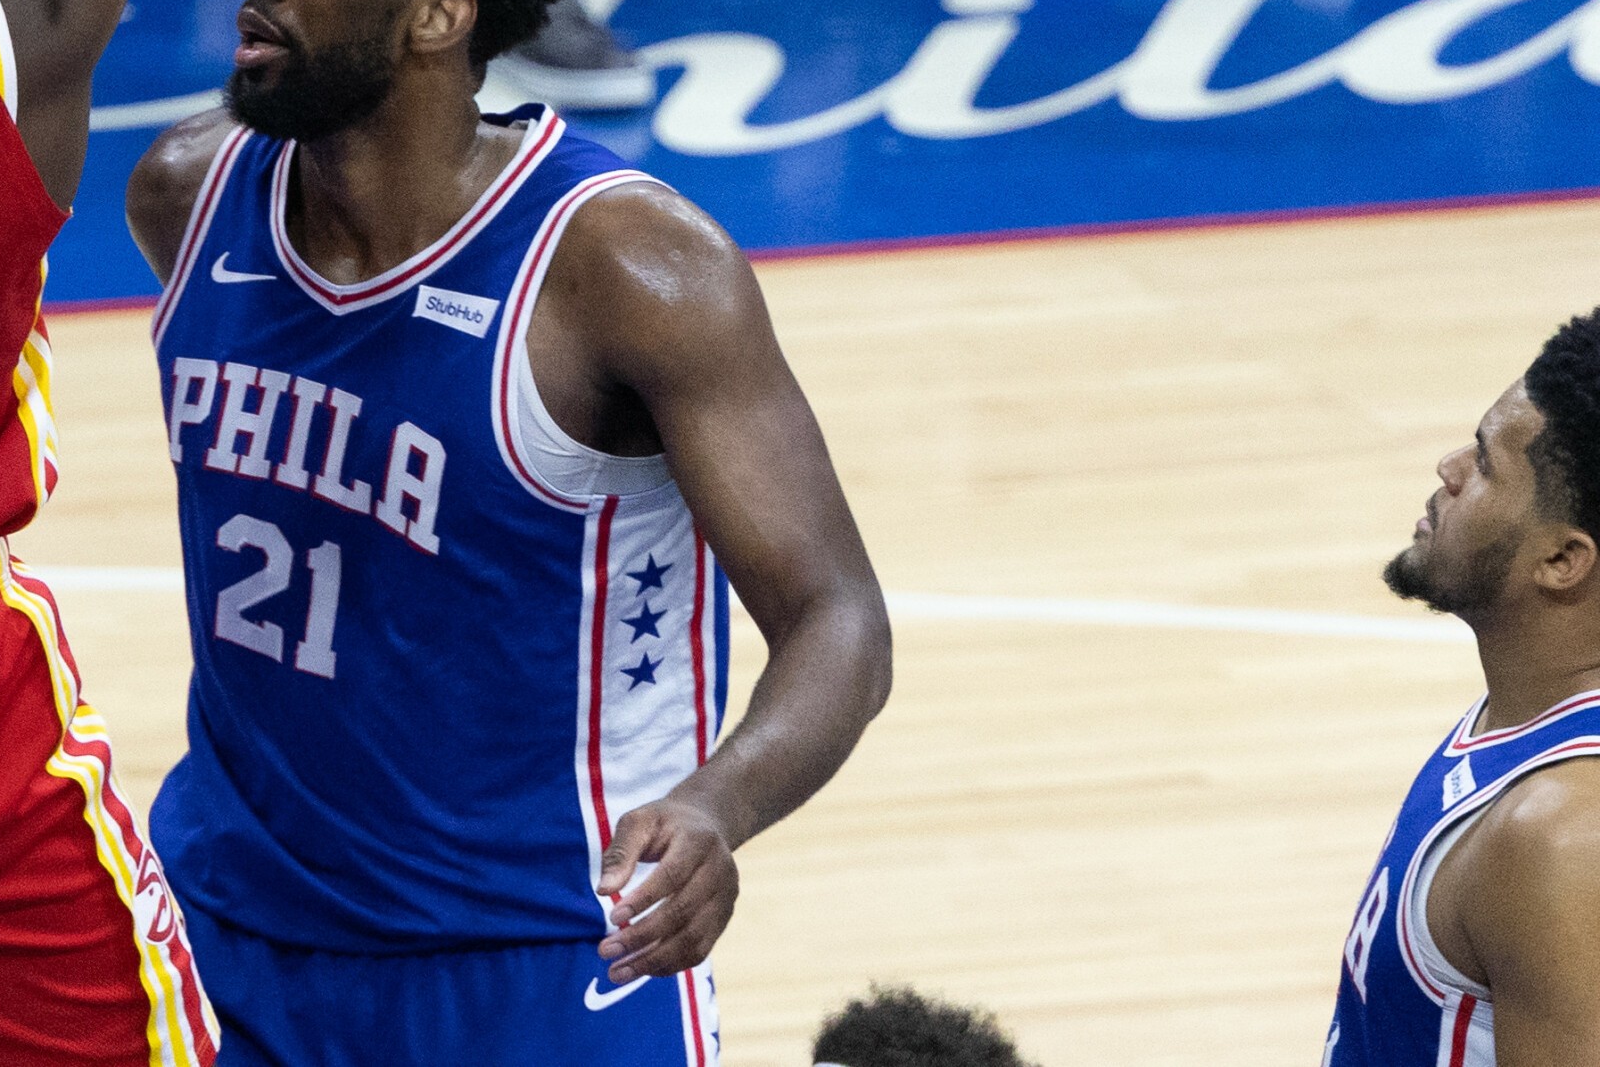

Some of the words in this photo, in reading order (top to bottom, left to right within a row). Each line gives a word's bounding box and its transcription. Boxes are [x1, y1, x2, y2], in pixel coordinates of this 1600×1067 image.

[425, 295, 484, 324] StubHub
[169, 356, 449, 556] PHILA
[213, 512, 343, 680] 21
